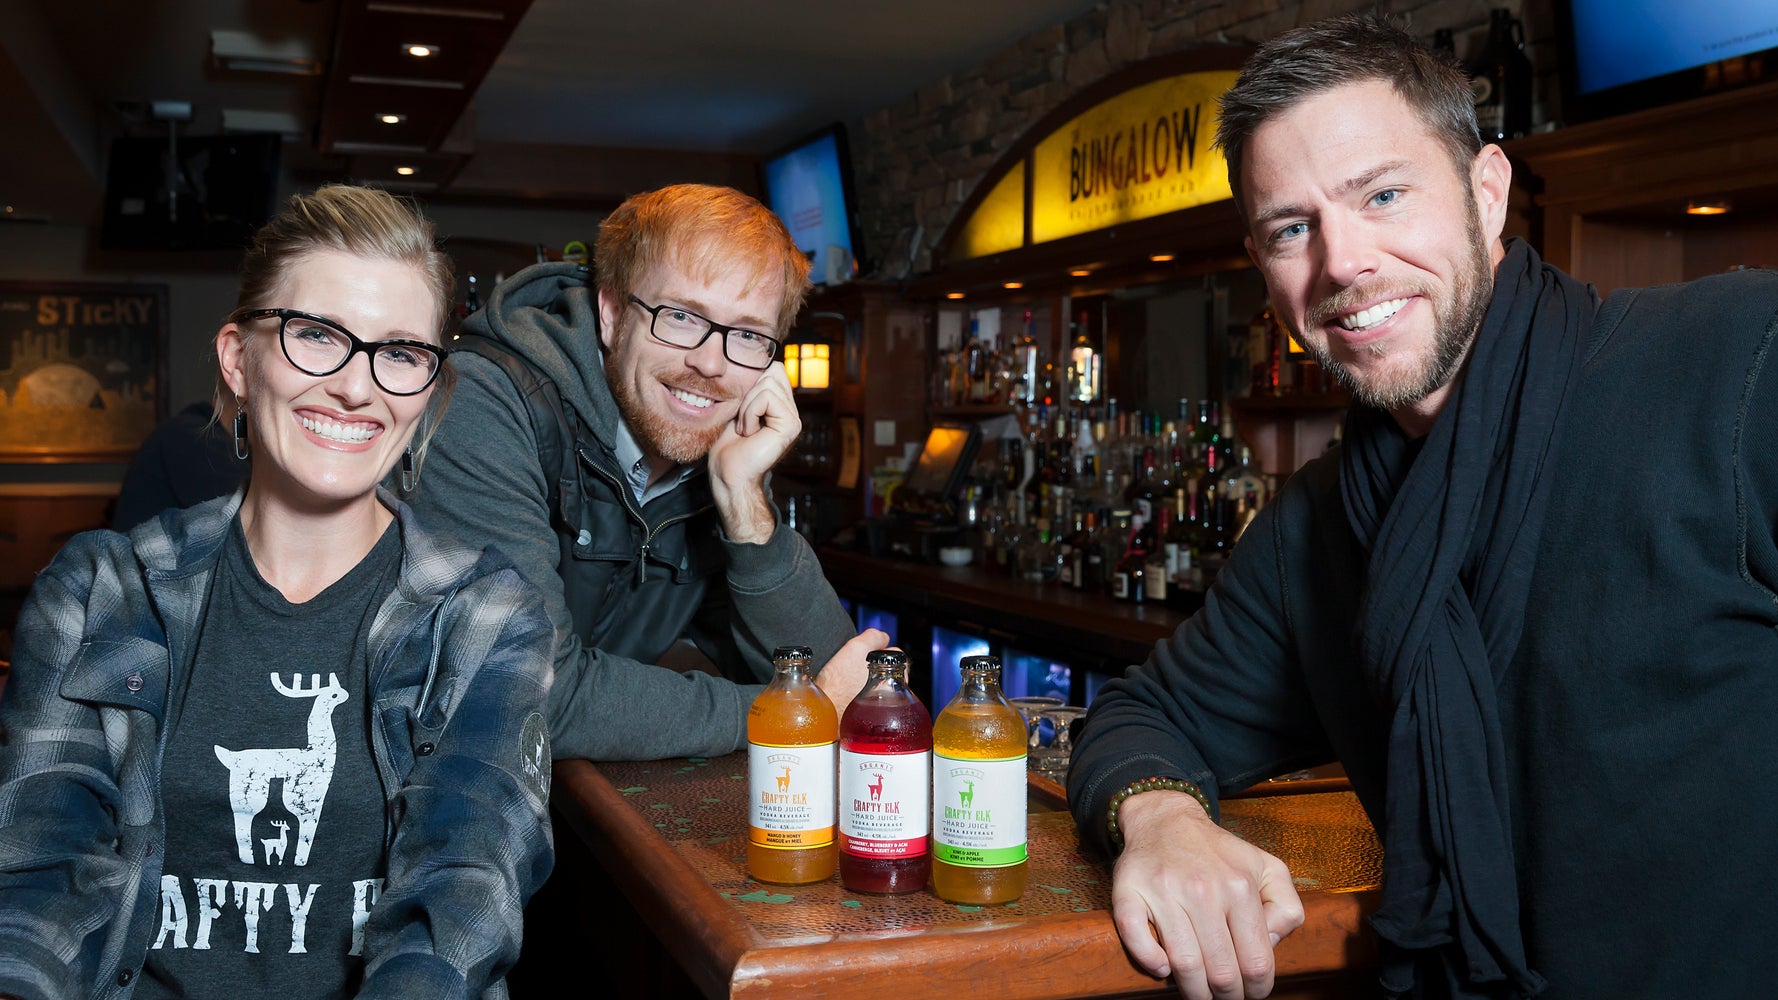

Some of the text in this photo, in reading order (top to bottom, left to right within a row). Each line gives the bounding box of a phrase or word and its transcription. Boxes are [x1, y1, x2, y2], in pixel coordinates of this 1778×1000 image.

[1070, 103, 1200, 203] BUNGALOW
[859, 762, 894, 772] ORGANIC
[762, 791, 808, 805] CRAFTY ELK
[853, 798, 900, 814] CRAFTY ELK
[944, 805, 991, 822] CRAFTY ELK
[946, 820, 965, 828] HARD
[150, 874, 322, 954] AFTY
